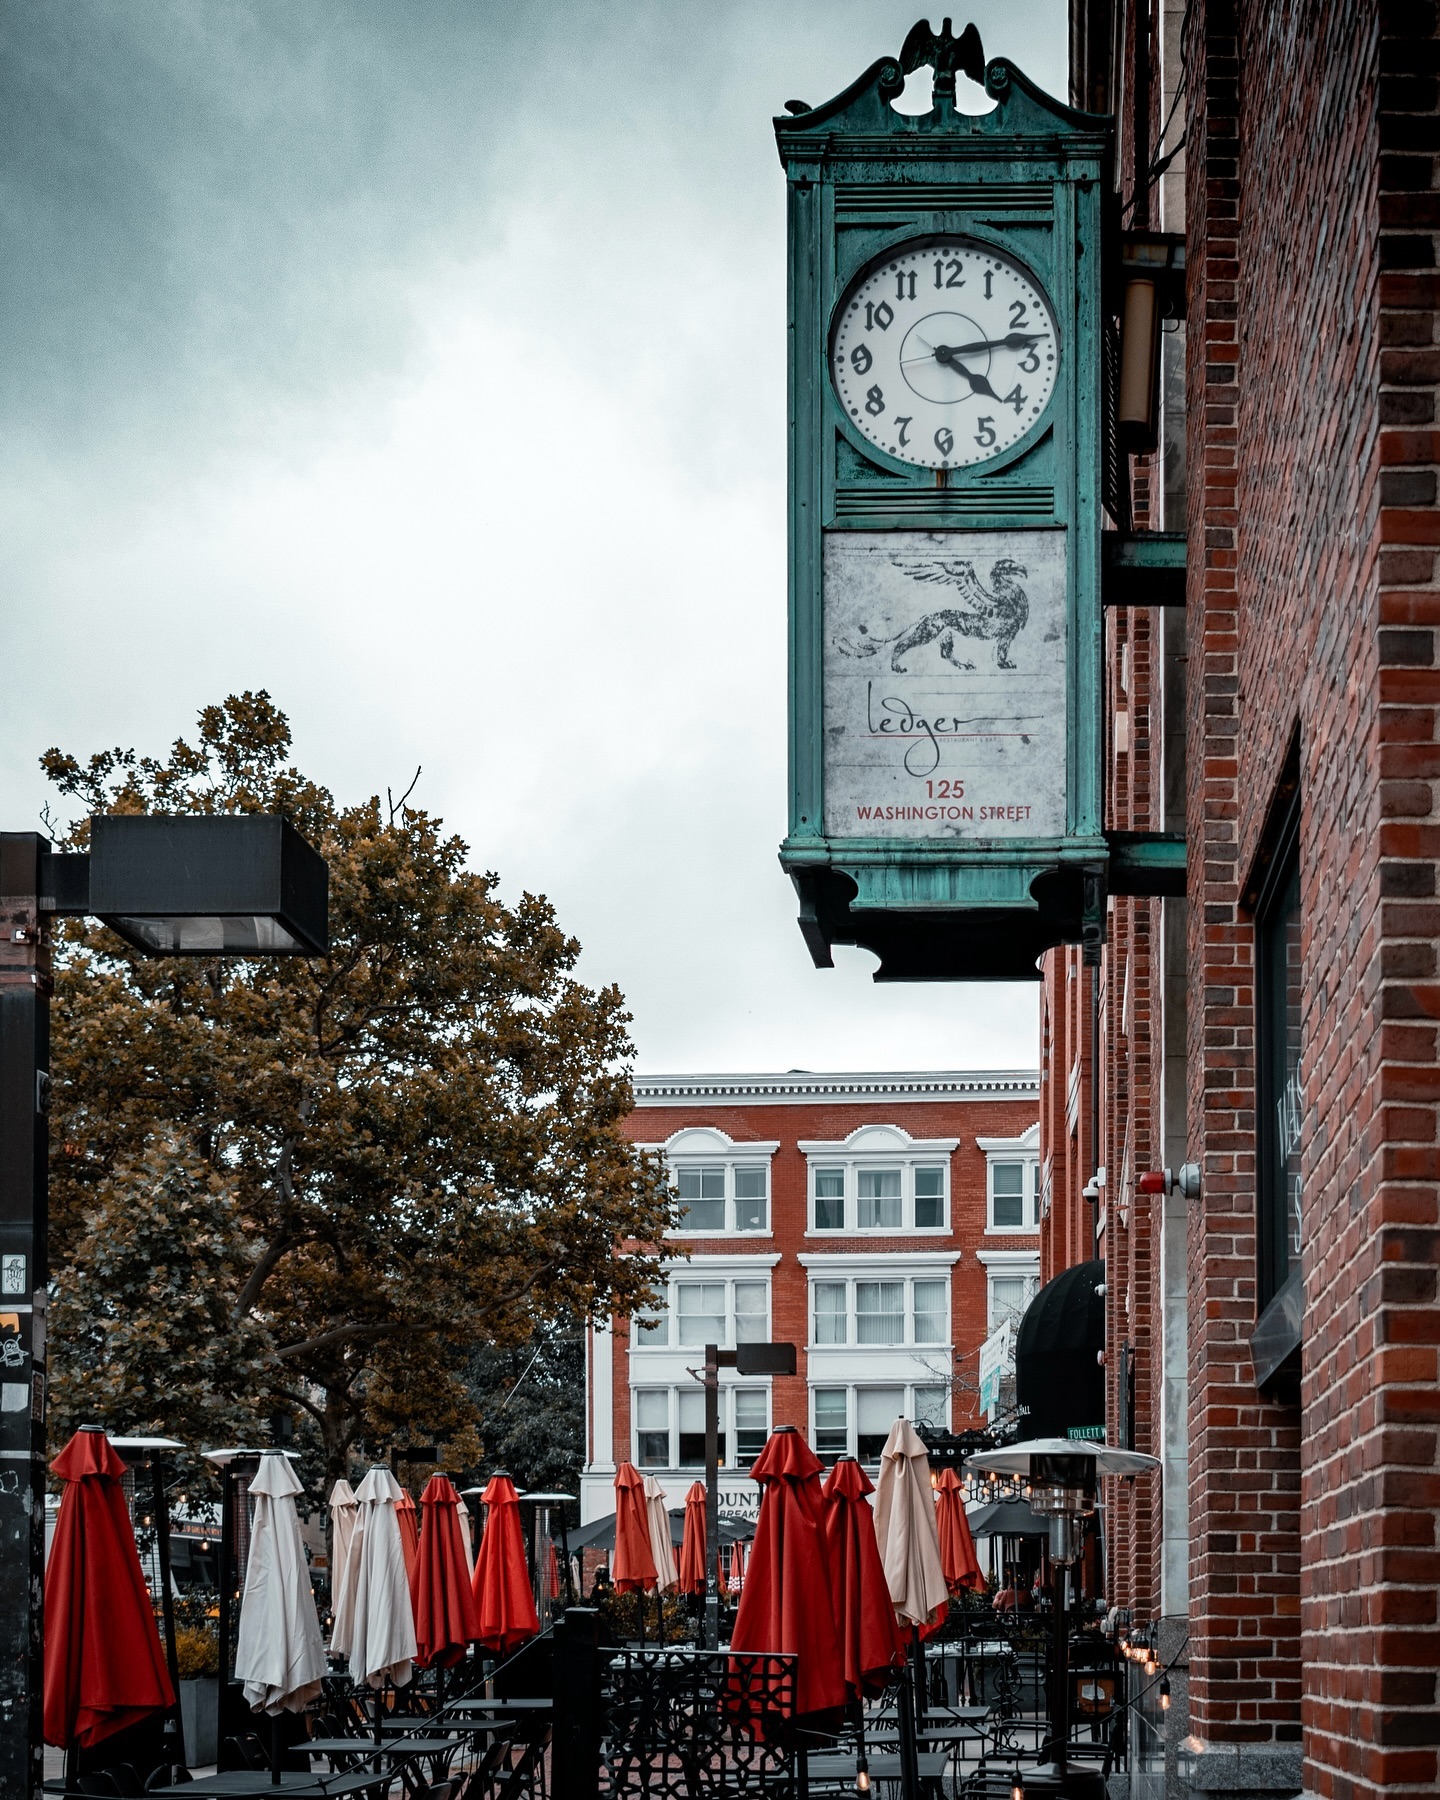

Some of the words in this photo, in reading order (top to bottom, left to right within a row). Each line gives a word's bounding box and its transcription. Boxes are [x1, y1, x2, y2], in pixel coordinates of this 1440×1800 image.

[894, 269, 918, 301] 11
[933, 258, 967, 291] 12
[983, 269, 995, 301] 1
[864, 300, 895, 332] 10
[1008, 300, 1030, 330] 2
[850, 343, 873, 376] 9
[1017, 343, 1041, 374] 3
[864, 384, 886, 417] 8
[1003, 383, 1029, 416] 4
[893, 416, 914, 448] 7
[933, 427, 955, 458] 6
[974, 416, 997, 448] 5
[868, 681, 1044, 777] ledger
[925, 780, 965, 799] 125
[856, 806, 974, 820] WASHINGTON
[979, 806, 1032, 821] STREET
[1069, 1427, 1099, 1440] FOLLETT
